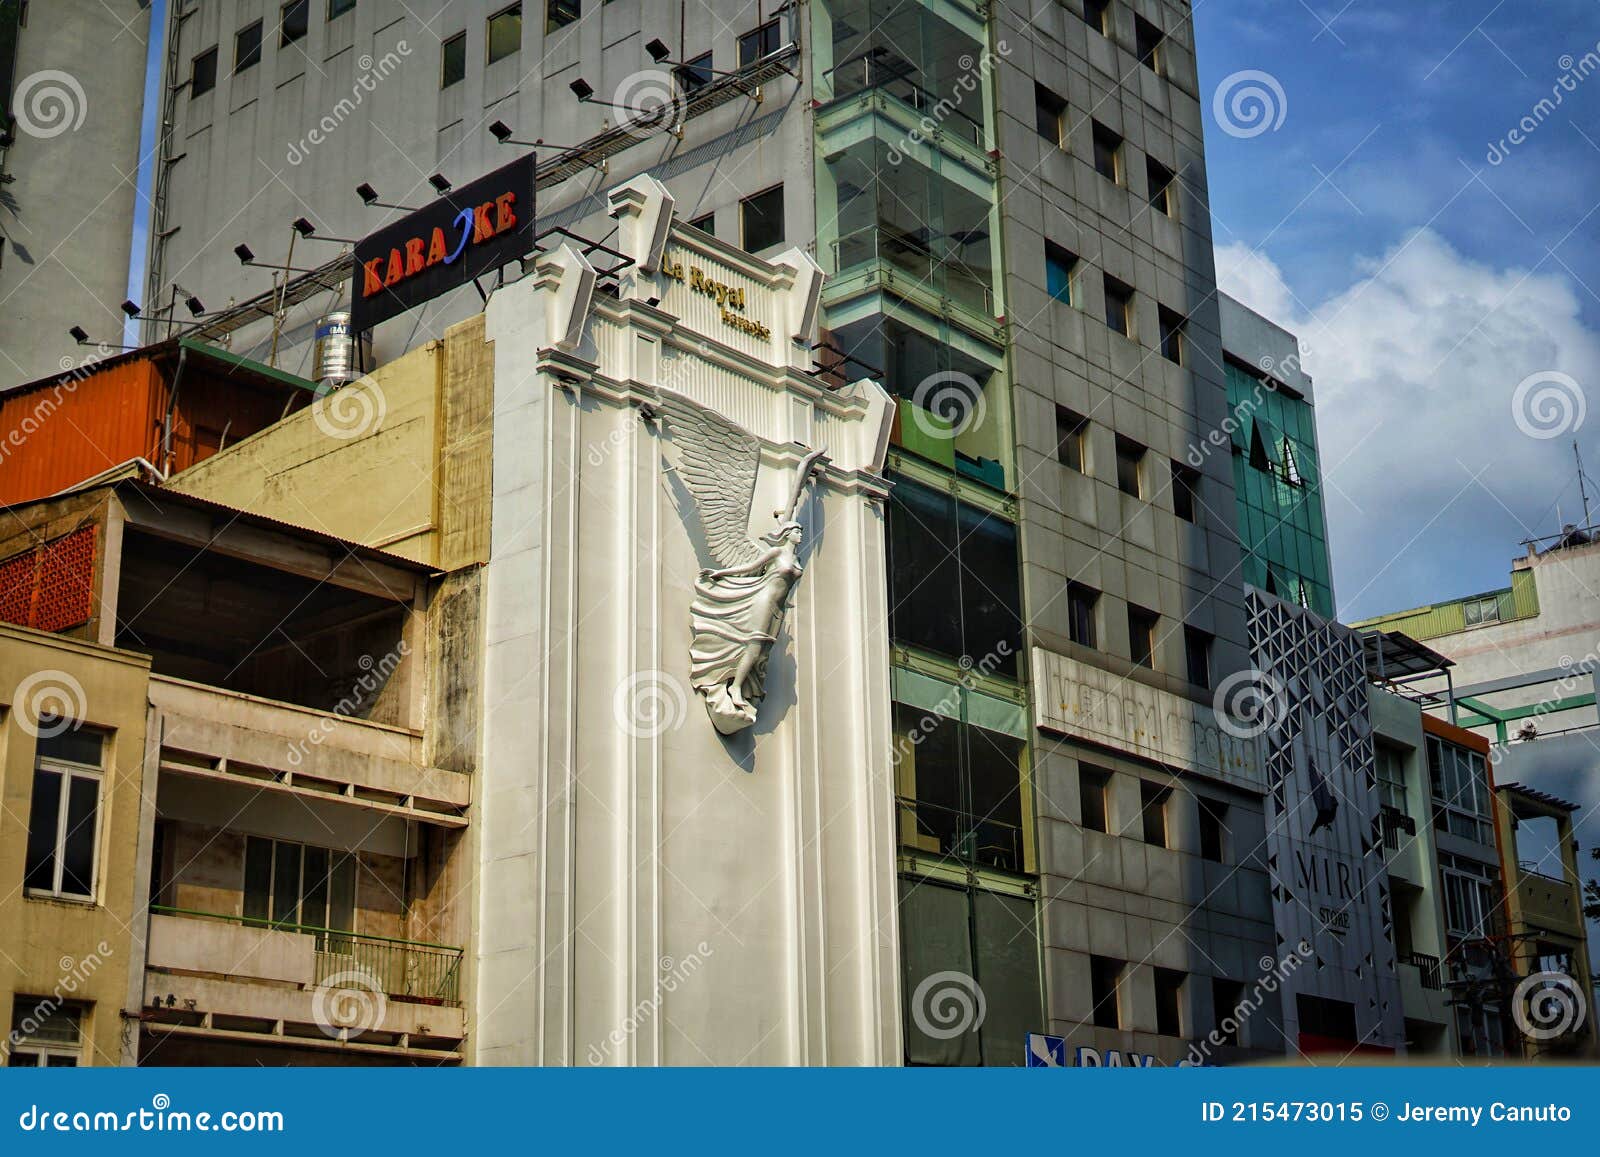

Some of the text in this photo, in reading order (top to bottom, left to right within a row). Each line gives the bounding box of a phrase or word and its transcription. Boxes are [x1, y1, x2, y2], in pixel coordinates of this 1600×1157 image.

[662, 254, 745, 311] La Royal
[1296, 850, 1366, 905] MIRI
[1319, 906, 1351, 930] STORE
